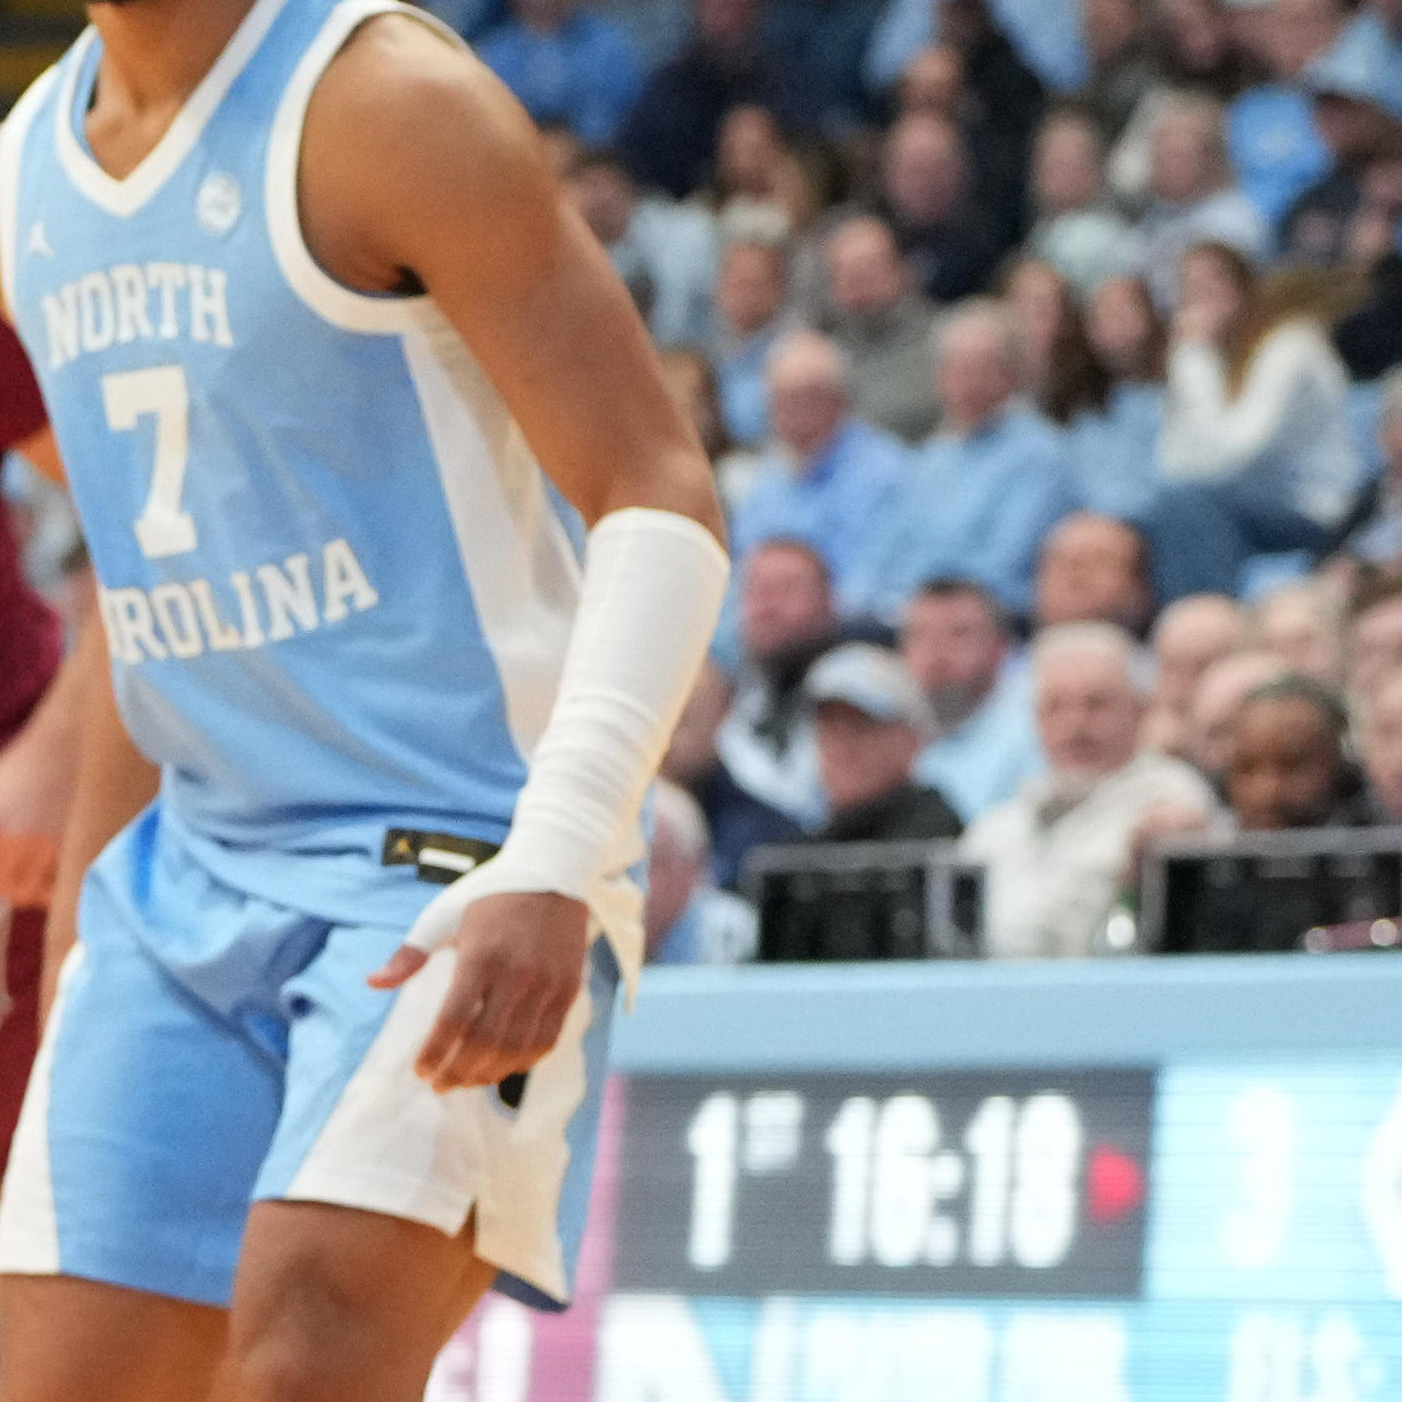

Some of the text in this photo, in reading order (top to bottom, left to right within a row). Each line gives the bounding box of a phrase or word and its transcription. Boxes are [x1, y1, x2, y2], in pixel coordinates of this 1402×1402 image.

[42, 262, 233, 370] NORTH
[102, 365, 198, 560] 7
[100, 538, 380, 665] ROLINA
